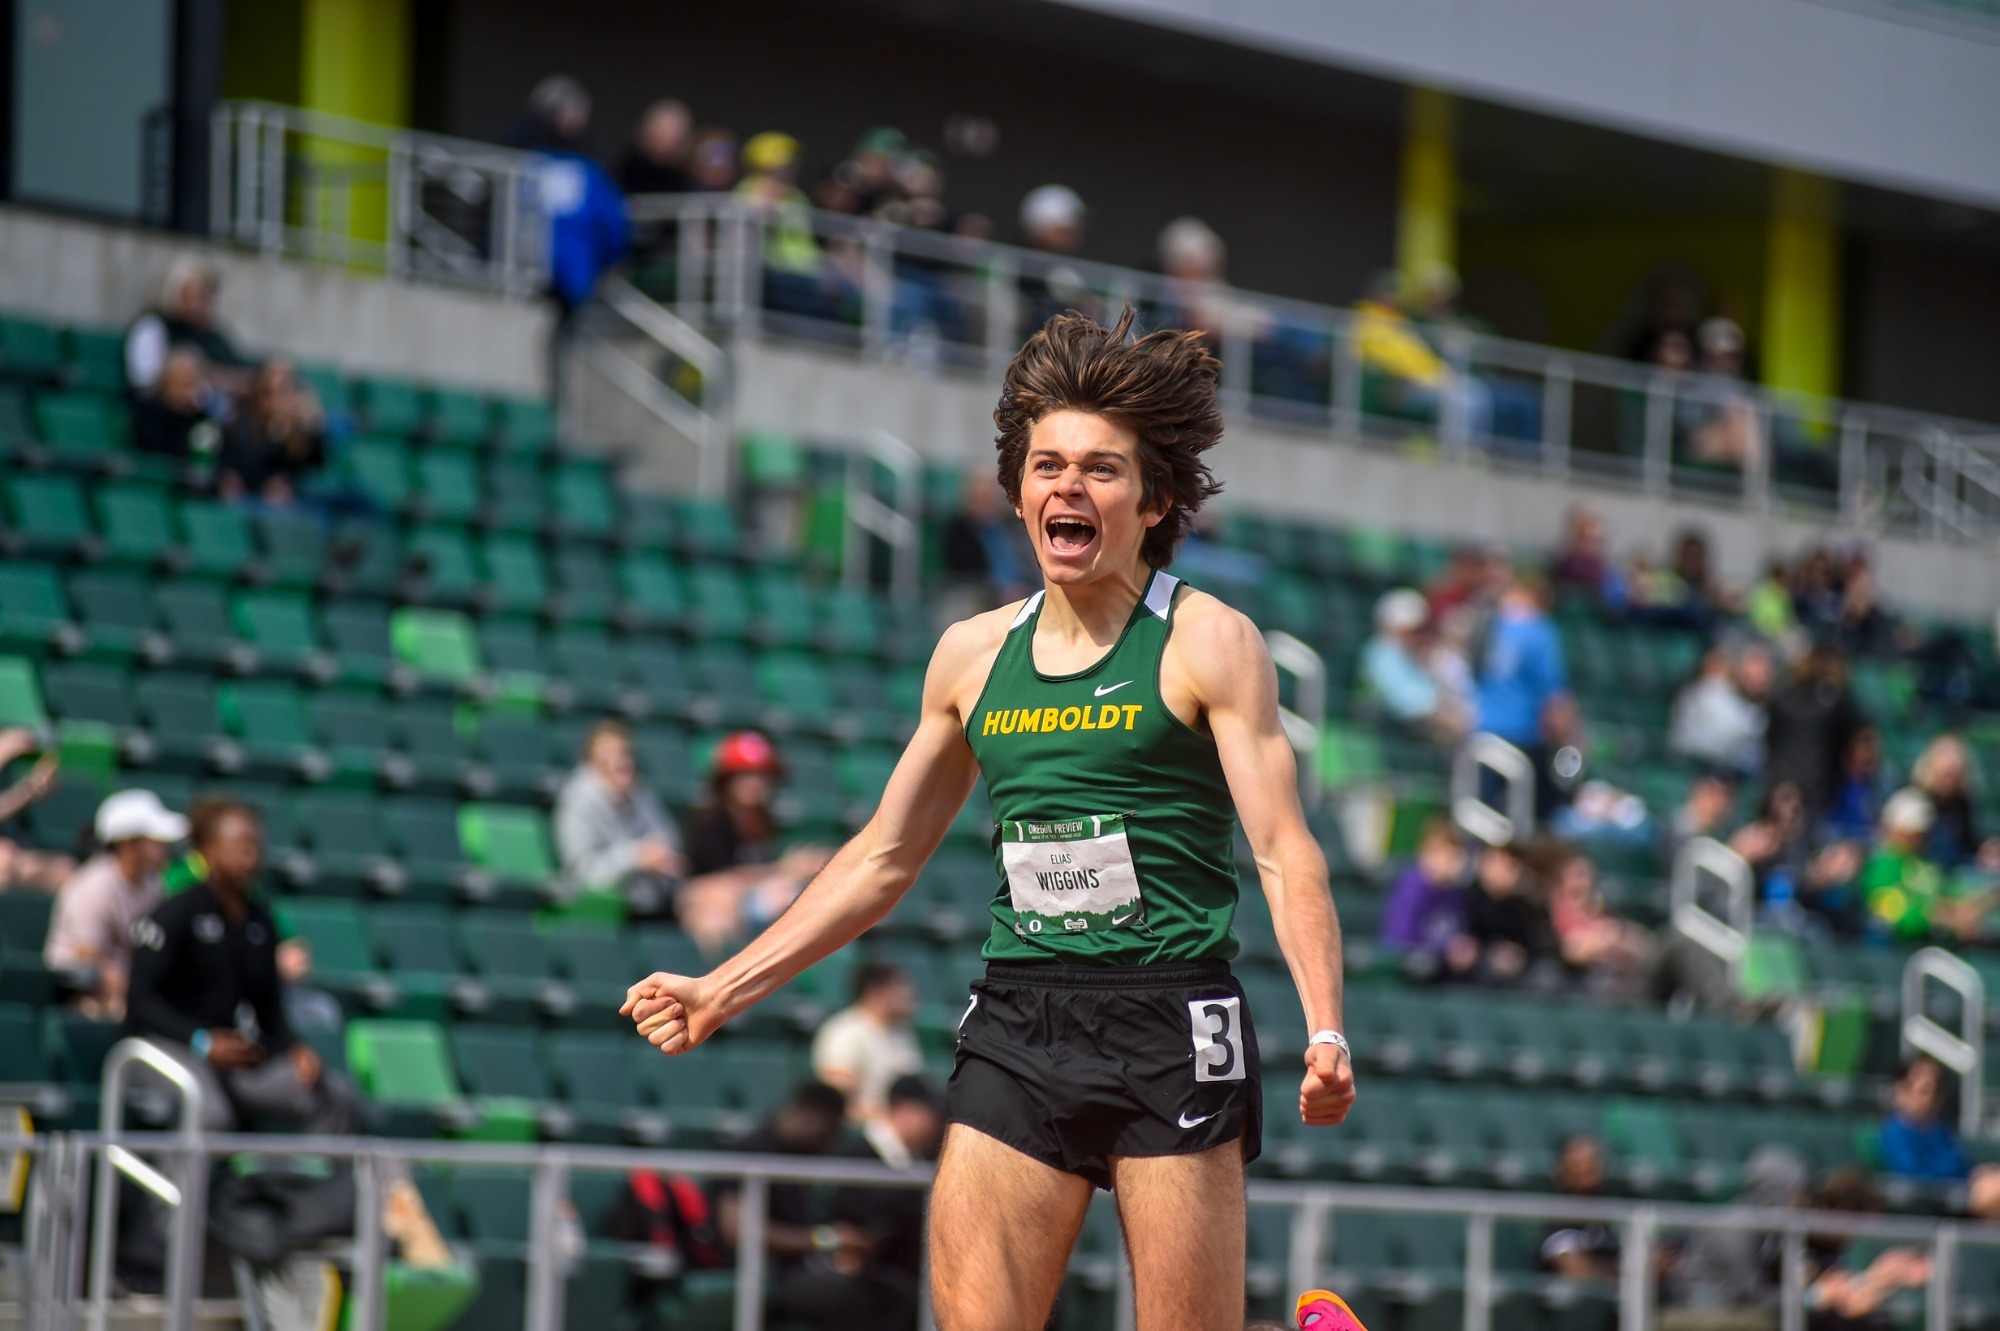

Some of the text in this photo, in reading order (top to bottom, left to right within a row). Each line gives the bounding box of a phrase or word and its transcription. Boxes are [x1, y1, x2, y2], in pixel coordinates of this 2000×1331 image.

[982, 705, 1143, 736] HUMBOLDT
[1028, 821, 1082, 834] OREGON PREVIEW
[1050, 854, 1072, 865] ELIAS
[1036, 868, 1100, 891] WIGGINS
[1202, 1003, 1235, 1077] 3
